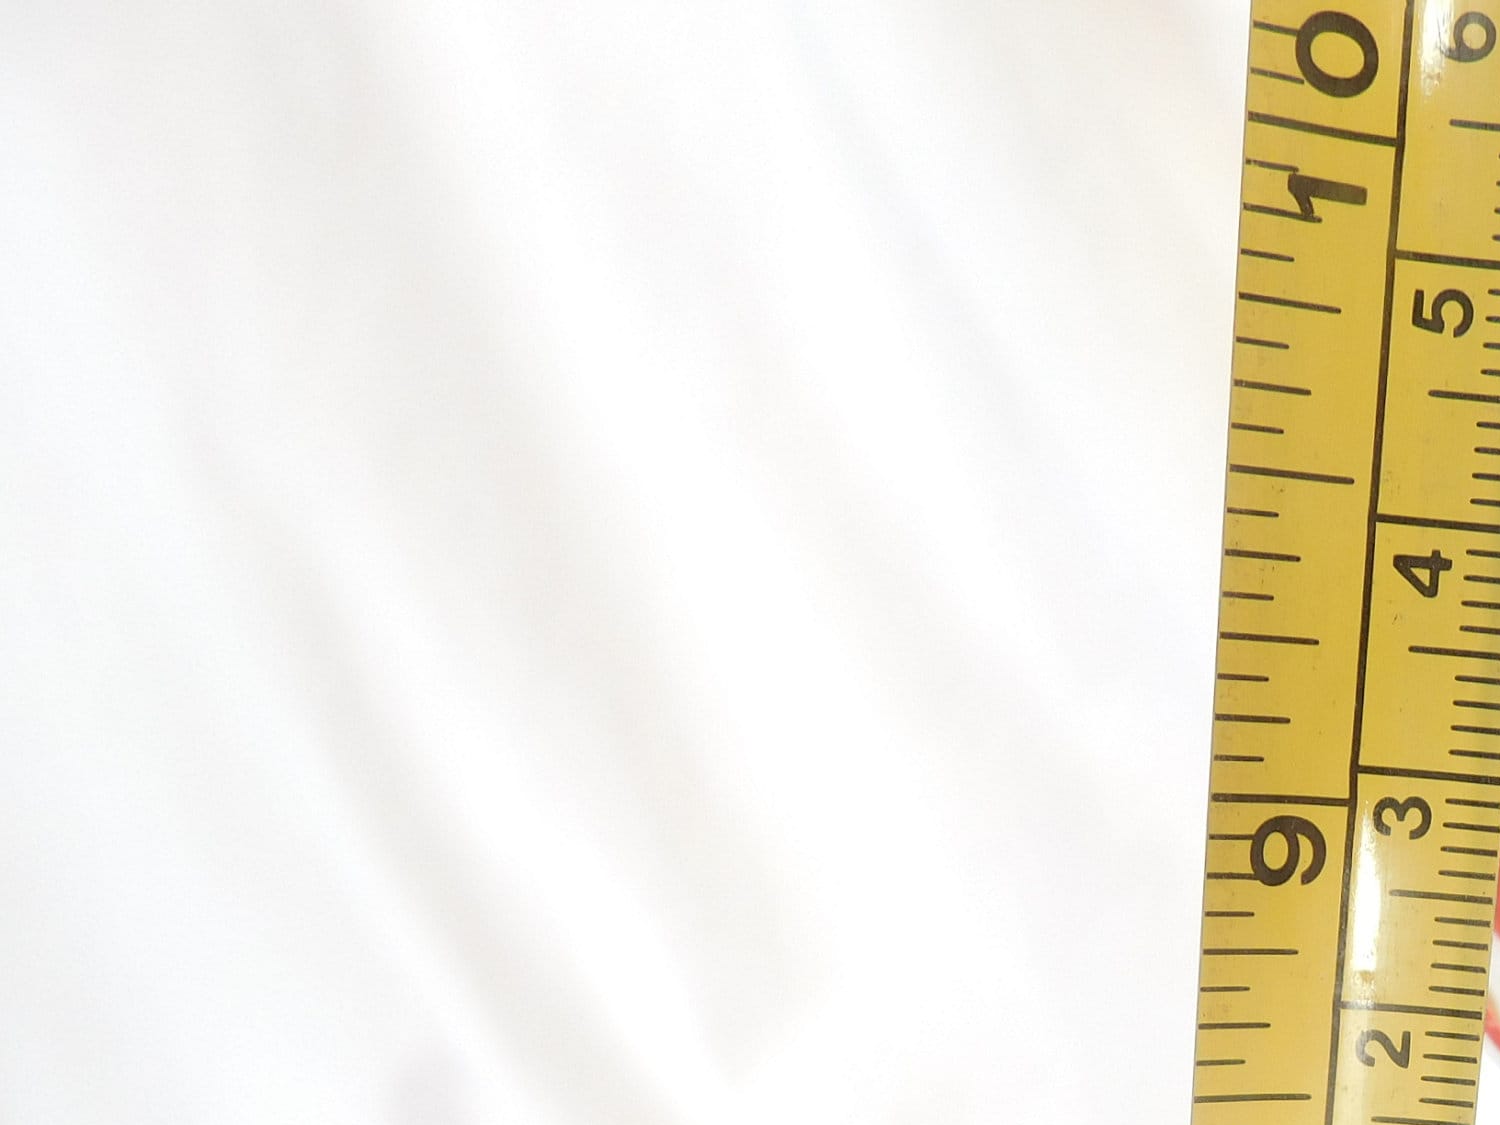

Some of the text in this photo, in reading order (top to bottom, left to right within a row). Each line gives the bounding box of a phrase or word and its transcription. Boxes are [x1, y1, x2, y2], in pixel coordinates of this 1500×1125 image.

[1444, 11, 1497, 63] 6
[1412, 288, 1474, 338] 5
[1393, 549, 1453, 598] 4
[1373, 795, 1432, 840] 3
[1250, 815, 1327, 886] 9
[1355, 1029, 1411, 1069] 2
